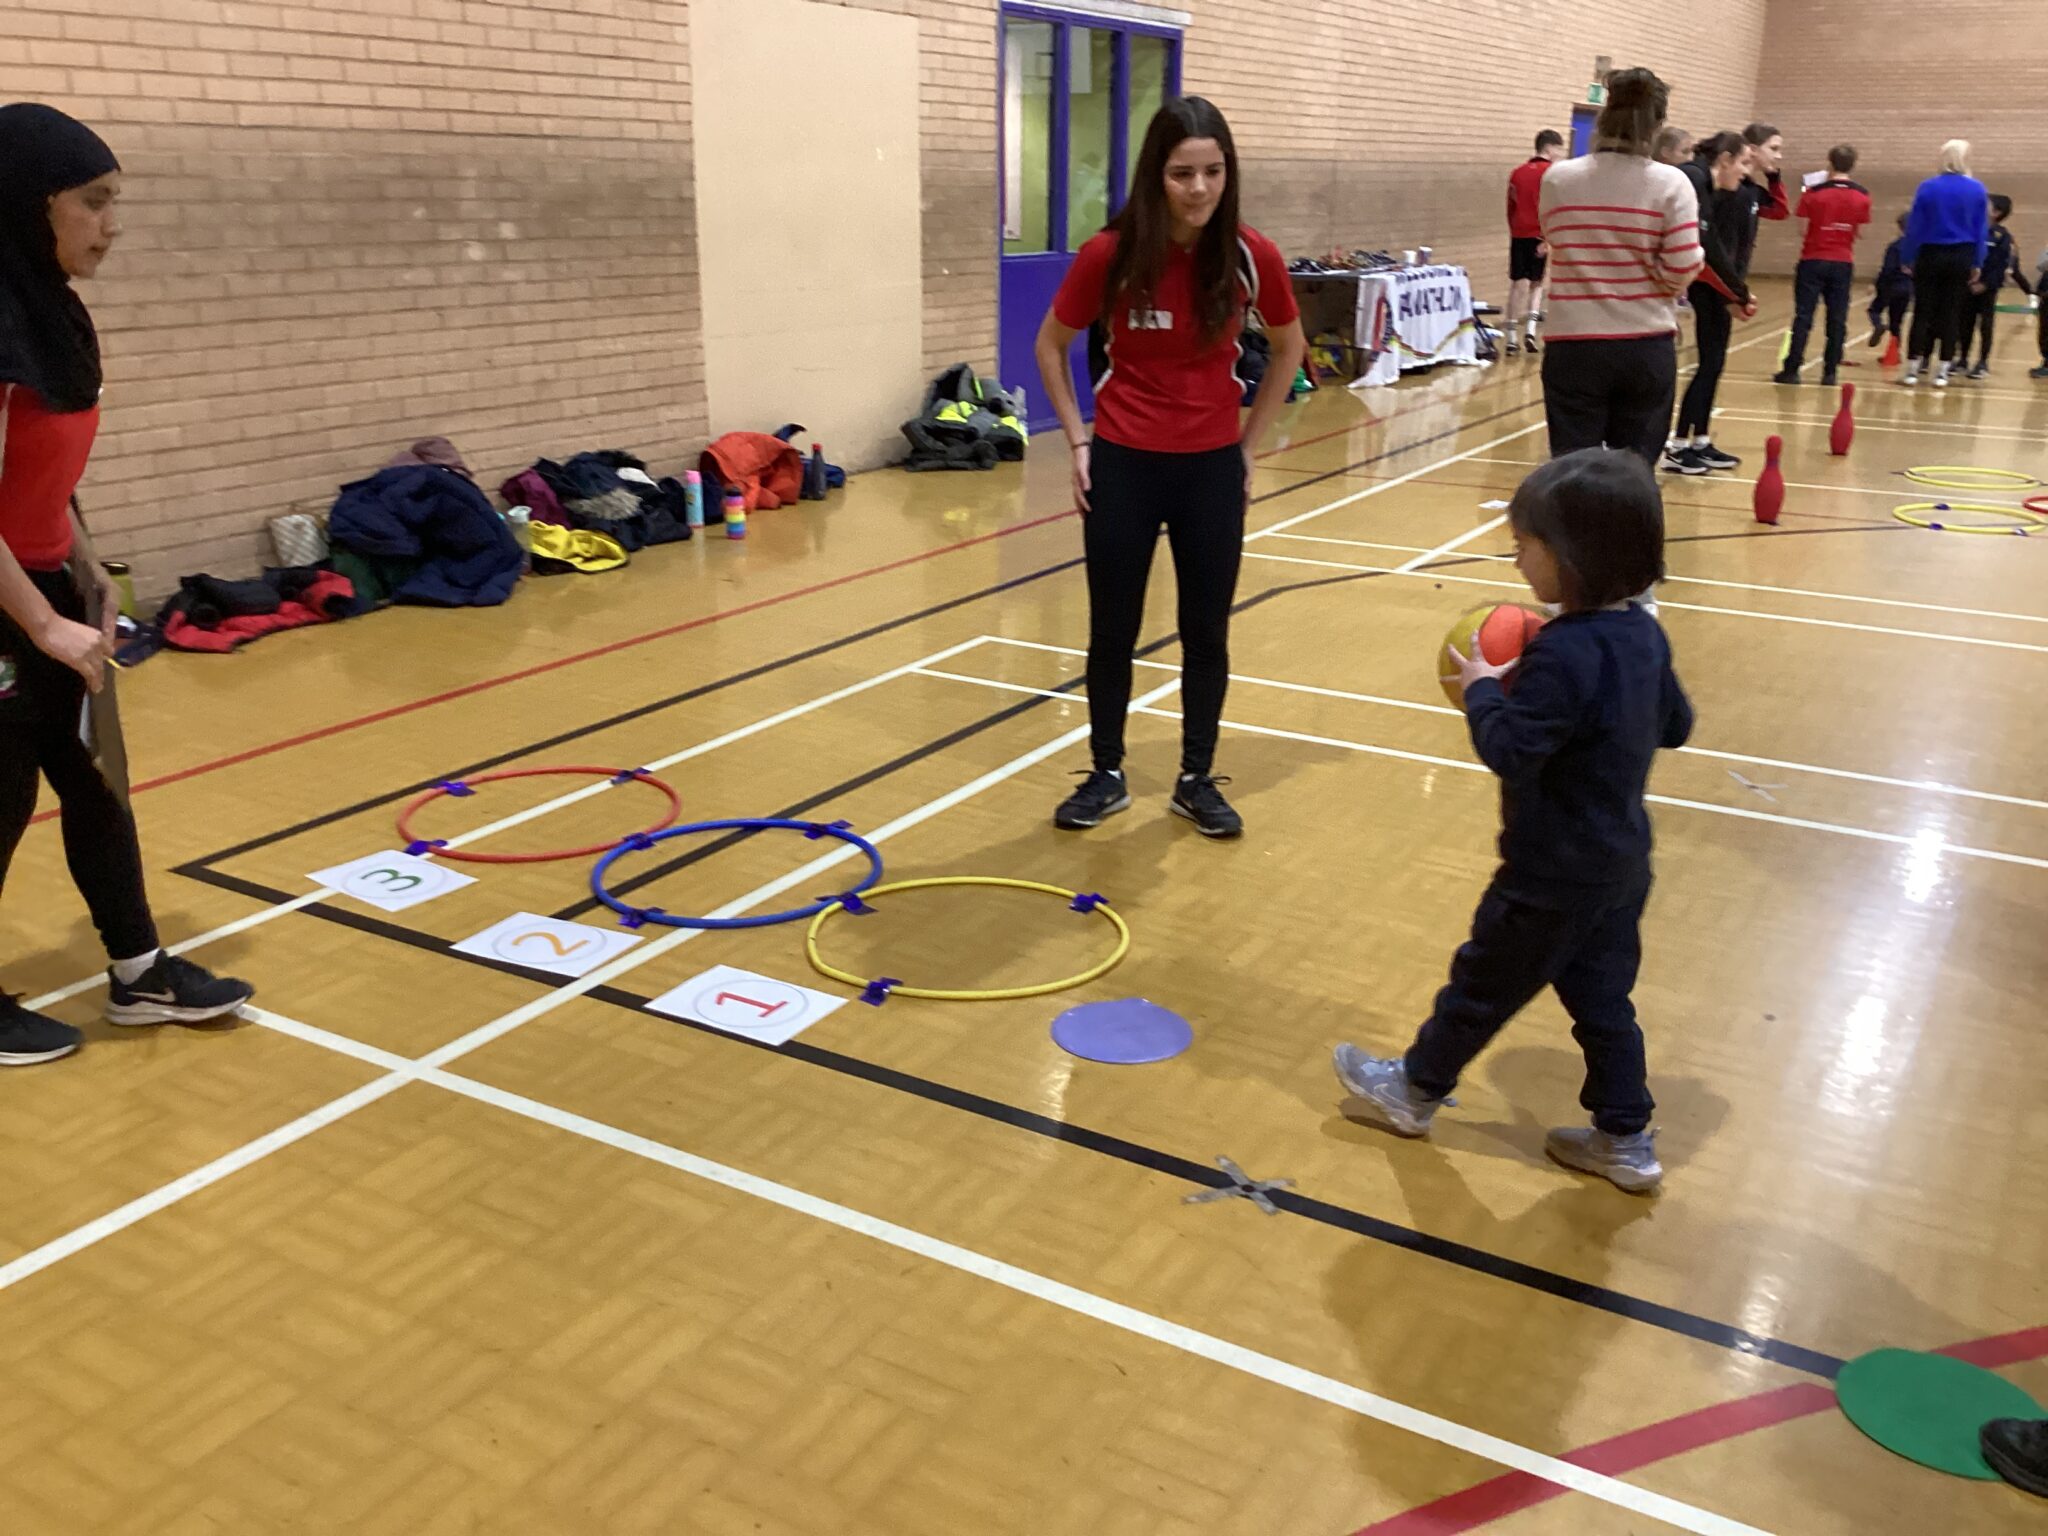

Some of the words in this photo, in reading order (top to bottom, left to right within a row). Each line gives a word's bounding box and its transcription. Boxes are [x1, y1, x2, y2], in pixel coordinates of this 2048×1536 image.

[360, 867, 423, 893] 3
[512, 931, 589, 957] 2
[715, 990, 789, 1019] 1
